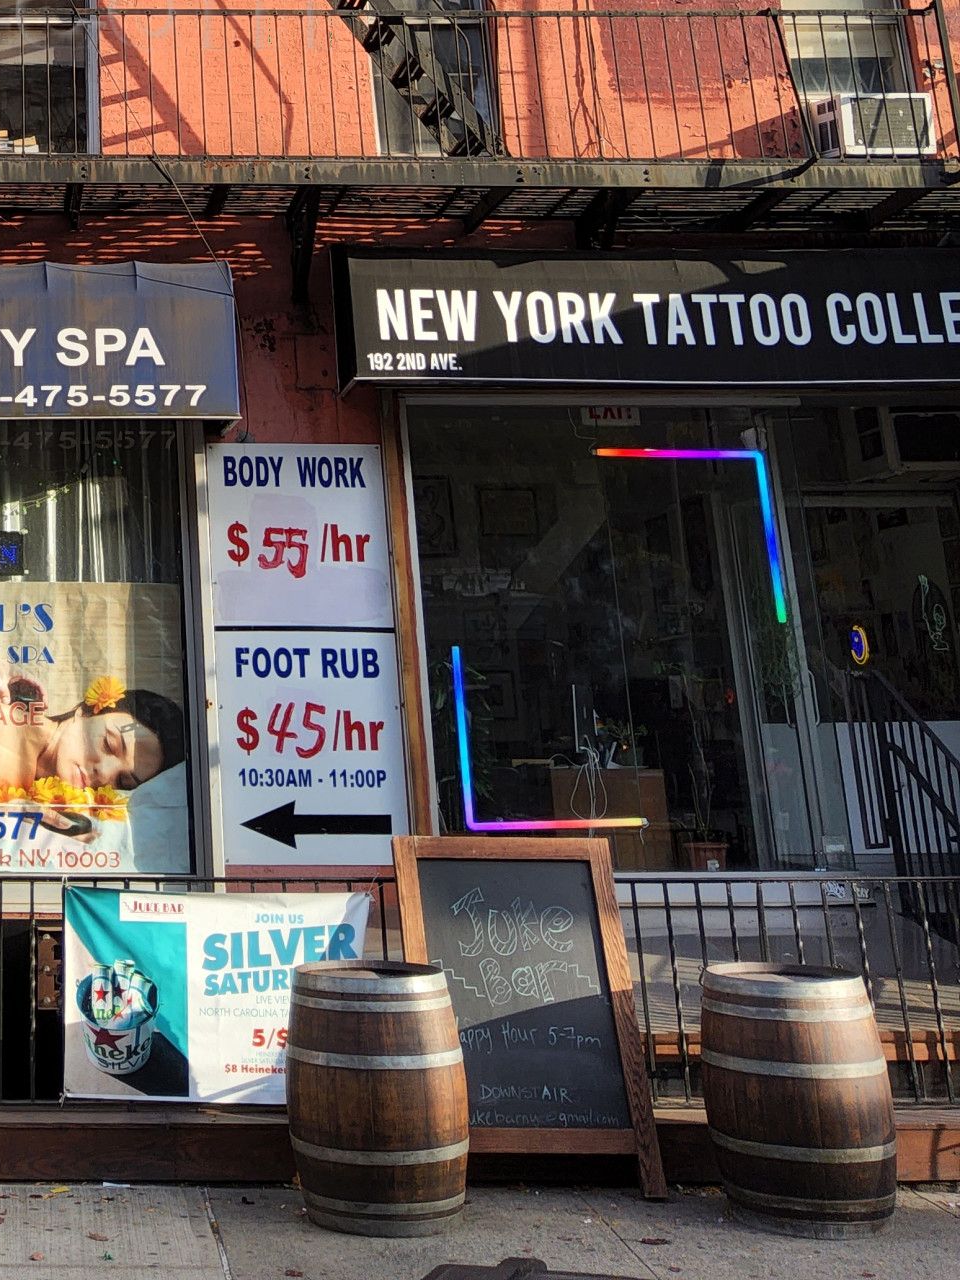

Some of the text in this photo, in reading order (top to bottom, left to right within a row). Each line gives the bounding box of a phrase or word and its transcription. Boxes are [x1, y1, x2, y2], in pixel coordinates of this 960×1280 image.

[376, 289, 477, 342] NEW
[492, 290, 624, 345] YORK
[633, 292, 812, 347] TATTOO
[56, 327, 166, 367] SPA
[366, 352, 463, 371] 192 2ND AVE.
[222, 455, 367, 489] BODY WORK
[6, 645, 55, 665] SPA
[235, 647, 381, 679] FOOT RUB
[238, 767, 313, 788] 10:30AM
[329, 768, 388, 788] 11:00P
[19, 848, 50, 868] NY
[56, 849, 121, 869] 10003
[130, 900, 185, 914] JUKE BAR
[255, 913, 305, 924] JOIN US
[450, 886, 575, 958] Juke
[202, 923, 358, 971] SILVER
[203, 969, 291, 997] SATUR
[478, 957, 569, 1008] Bar
[274, 995, 290, 1005] VIE
[199, 1008, 231, 1018] NORTH
[233, 1008, 279, 1018] CAROLINA
[457, 1025, 491, 1053] appy
[501, 1021, 539, 1049] Hour
[224, 1063, 238, 1074] $8
